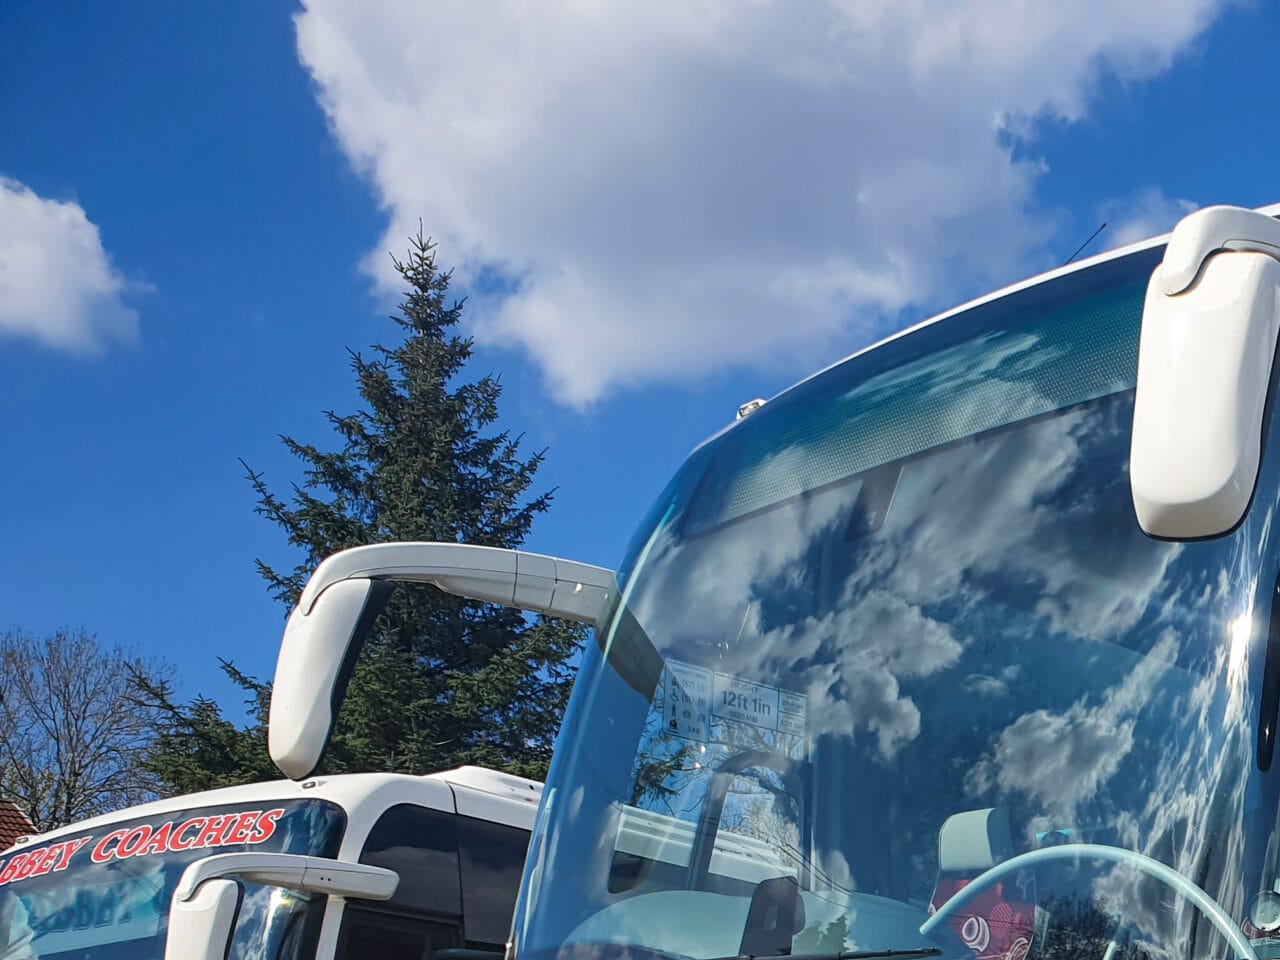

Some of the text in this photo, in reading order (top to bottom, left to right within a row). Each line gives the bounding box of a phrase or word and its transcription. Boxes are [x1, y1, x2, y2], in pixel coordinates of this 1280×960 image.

[721, 690, 748, 710] 12ft
[751, 696, 771, 715] 1in
[0, 809, 285, 885] BBEY COACHES
